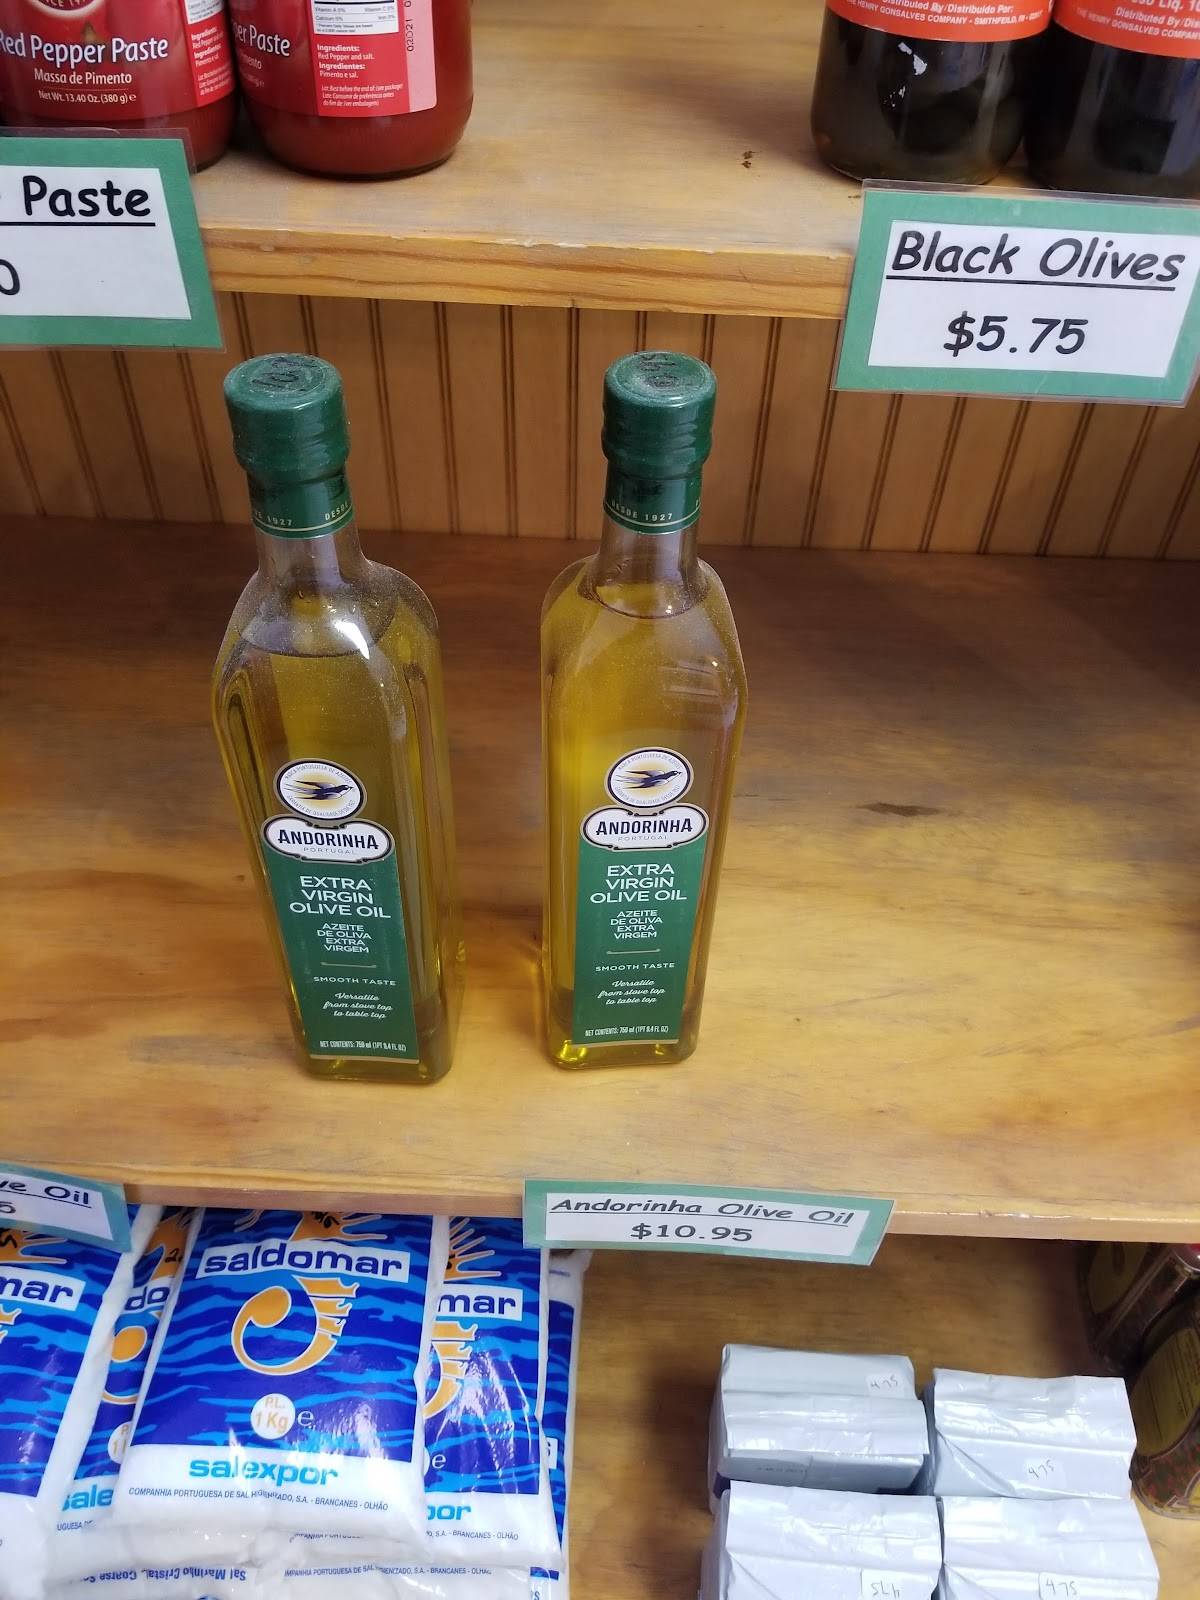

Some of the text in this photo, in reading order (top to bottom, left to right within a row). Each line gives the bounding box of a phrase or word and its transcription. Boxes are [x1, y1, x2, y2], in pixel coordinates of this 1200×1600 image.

[880, 5, 925, 21] GONSALVES
[928, 14, 967, 25] COMPANY
[1115, 7, 1164, 24] Distributed
[1111, 20, 1159, 35] GONSALVES
[249, 24, 291, 56] Paste
[30, 34, 106, 69] Pepper
[112, 37, 169, 63] Paste
[317, 44, 360, 53] Ingredients:
[319, 62, 366, 71] Ingredientes:
[34, 68, 133, 84] Massa de Pimento
[320, 70, 344, 78] Pimento
[38, 90, 50, 100] Net
[66, 93, 86, 102] 13.40
[101, 94, 118, 104] (380
[22, 175, 151, 218] Paste
[892, 230, 1185, 282] Black Olives
[943, 310, 1089, 357] $5.75
[266, 513, 292, 527] 1927
[645, 512, 673, 522] 1927
[595, 818, 693, 836] ANDORINHA
[278, 829, 379, 850] ANDORINHA
[607, 863, 675, 877] EXTRA
[300, 876, 372, 891] EXTRA
[606, 877, 674, 890] VIRGIN
[301, 889, 374, 905] VIRGIN
[590, 889, 687, 904] OLIVE OIL
[289, 902, 391, 919] OLIVE OIL
[616, 909, 658, 918] AZEITE
[322, 923, 364, 932] AZEITE
[610, 916, 663, 926] DE OLIVA
[617, 924, 655, 932] EXTRA
[317, 930, 372, 940] DE OLIVA
[613, 931, 657, 940] VIRGEM
[326, 938, 365, 946] EXTRA
[324, 945, 369, 953] VIRGEM
[595, 964, 639, 972] SMOOTH
[313, 976, 397, 986] SMOOTH TASTE
[612, 979, 655, 988] Versatile
[334, 992, 379, 1001] Versatile
[597, 987, 665, 999] from stove top
[322, 1001, 393, 1011] from stove top
[617, 996, 640, 1004] table
[642, 996, 657, 1004] top
[345, 1010, 369, 1018] table
[371, 1010, 387, 1019] top
[585, 1029, 594, 1037] NET
[320, 1040, 329, 1048] NET
[44, 1185, 89, 1205] Oil
[551, 1198, 855, 1227] Andorinha Olive Oil
[630, 1222, 753, 1243] $10.95
[204, 1241, 403, 1278] saldomar
[255, 1411, 289, 1434] 1 Kg
[189, 1455, 339, 1487] salexpor
[128, 1487, 172, 1497] COMPANHIA
[173, 1489, 223, 1498] PORTUGUESA
[224, 1489, 235, 1498] DE
[235, 1490, 249, 1499] SAL
[296, 1495, 309, 1504] S.A.
[315, 1497, 358, 1508] BRANCANES
[453, 1529, 491, 1539] BRANCANES
[230, 1568, 247, 1581] Sal
[314, 1567, 352, 1576] PORTUGUESA
[353, 1566, 361, 1574] DE
[430, 1567, 467, 1575] BRANCANES
